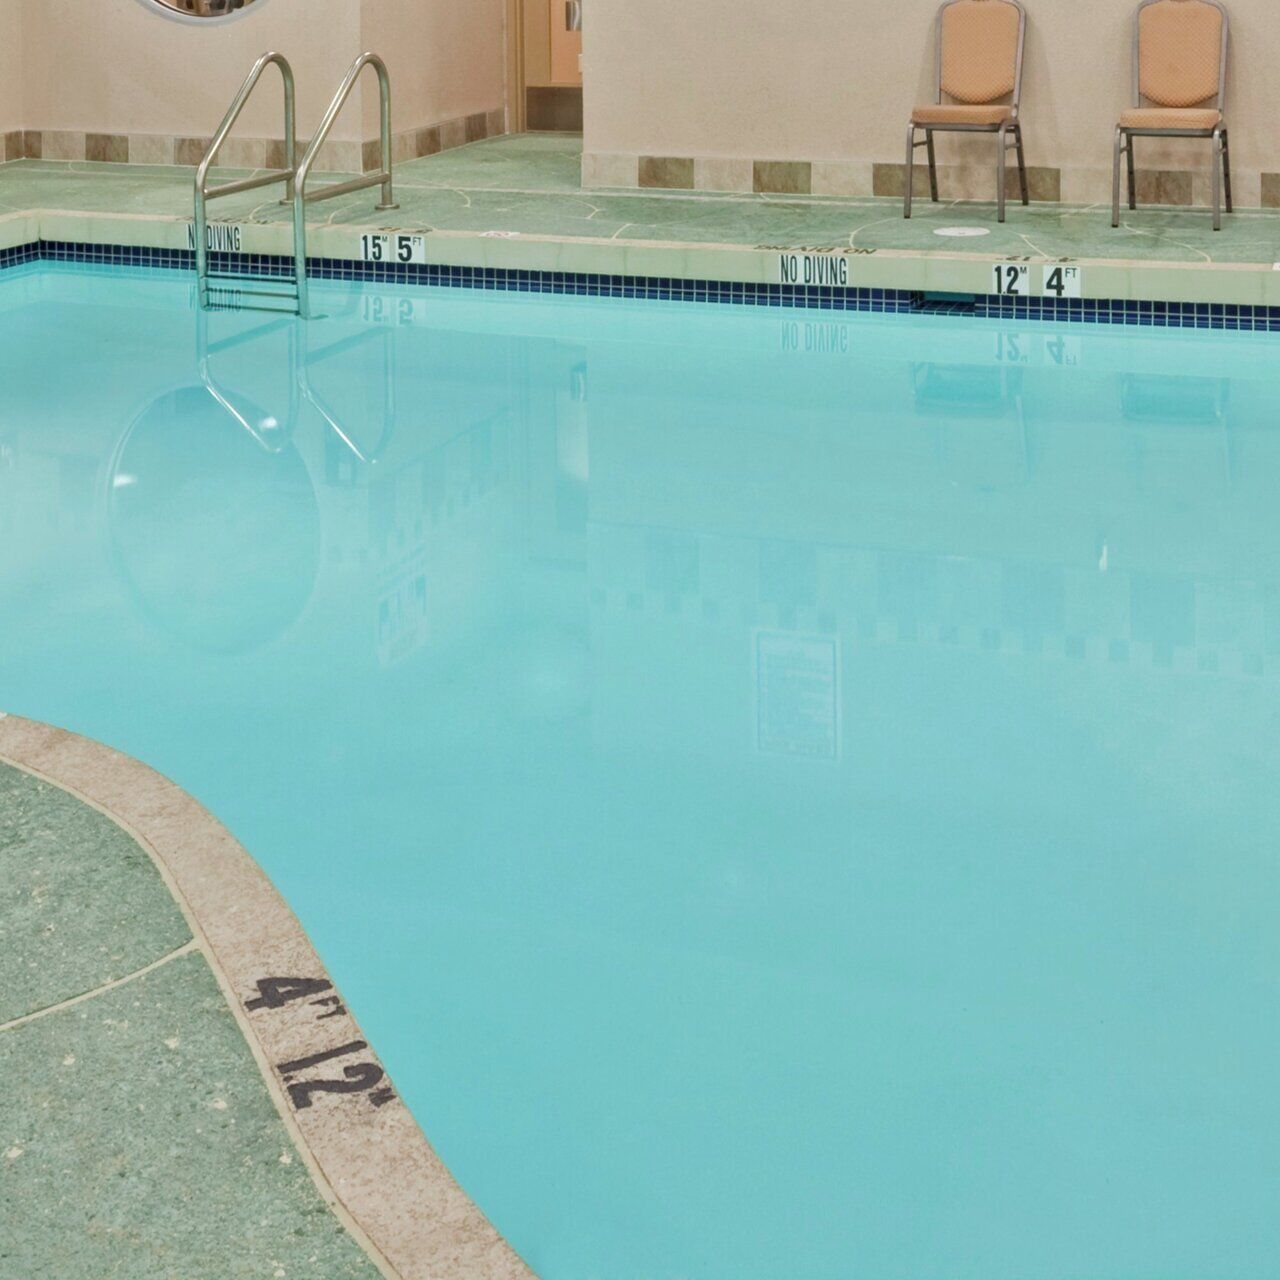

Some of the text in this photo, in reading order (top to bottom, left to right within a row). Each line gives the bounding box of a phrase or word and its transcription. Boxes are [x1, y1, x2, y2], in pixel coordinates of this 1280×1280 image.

[206, 225, 240, 251] DIVING
[780, 254, 847, 285] NO DIVING
